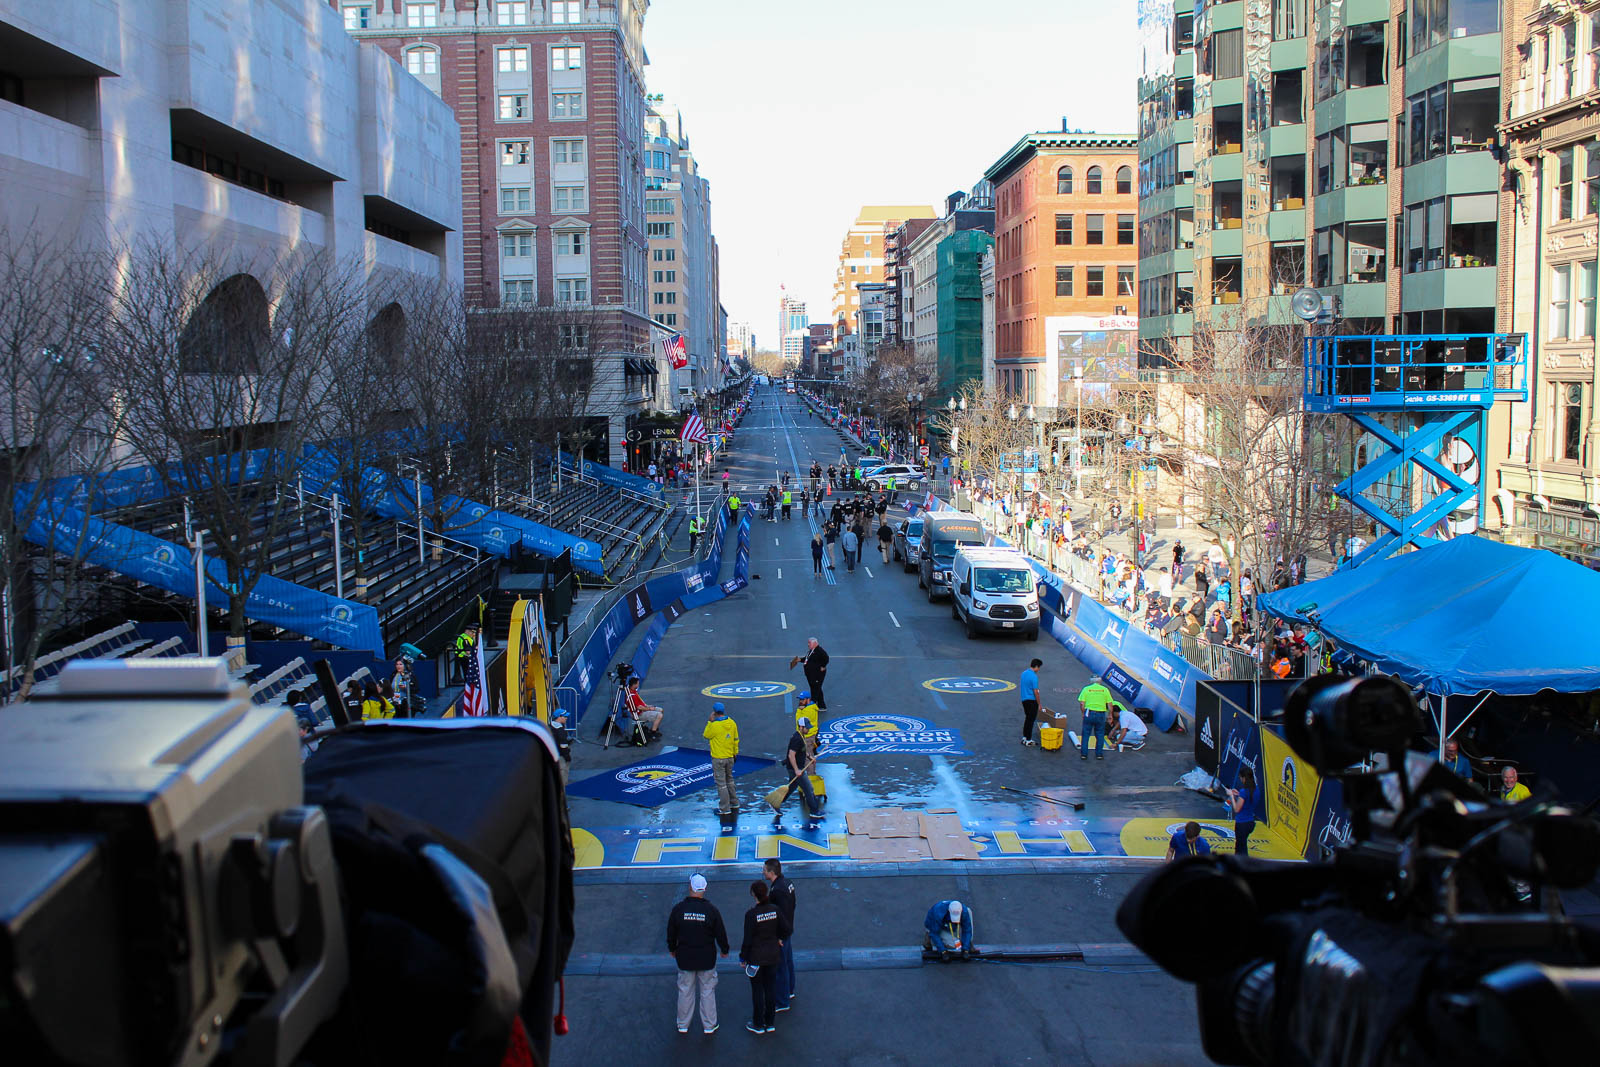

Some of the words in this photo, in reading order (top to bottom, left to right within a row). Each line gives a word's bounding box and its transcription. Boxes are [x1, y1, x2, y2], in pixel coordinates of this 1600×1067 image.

[652, 428, 676, 436] LENOX
[267, 597, 290, 611] DAY
[717, 685, 780, 694] 2017
[865, 730, 951, 738] BOSTON
[819, 736, 954, 744] MARATHON
[1029, 819, 1090, 827] 2017
[721, 823, 822, 832] BOSTON
